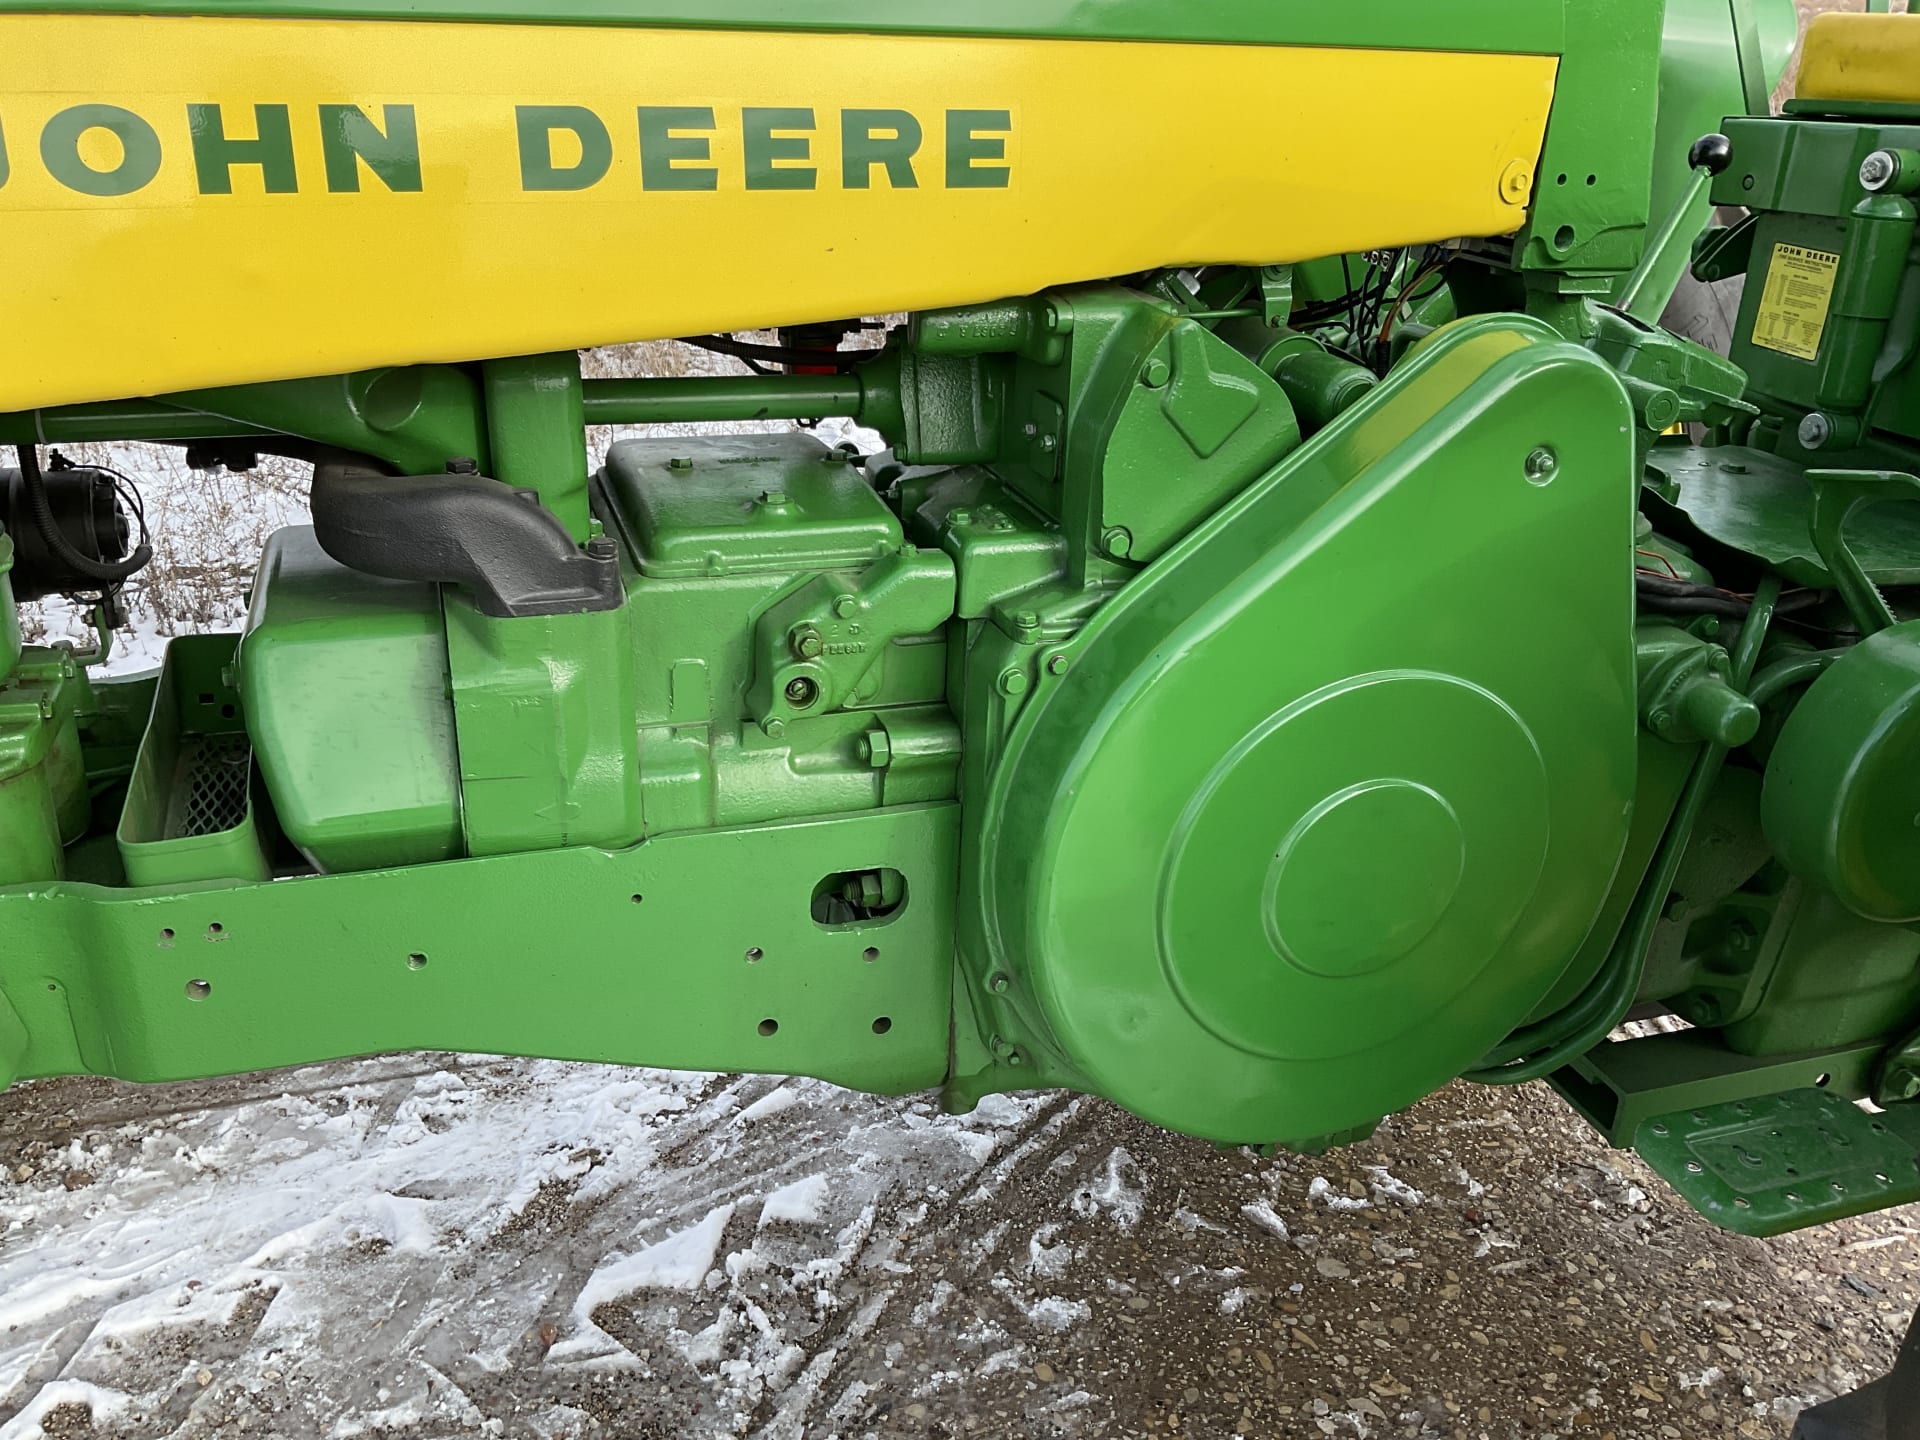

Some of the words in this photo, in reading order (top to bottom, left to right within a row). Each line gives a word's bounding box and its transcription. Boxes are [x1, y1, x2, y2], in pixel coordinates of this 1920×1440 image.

[0, 103, 424, 196] OHN
[515, 105, 1012, 191] DEERE
[1778, 245, 1802, 256] JOHN
[1806, 251, 1837, 263] DEERE
